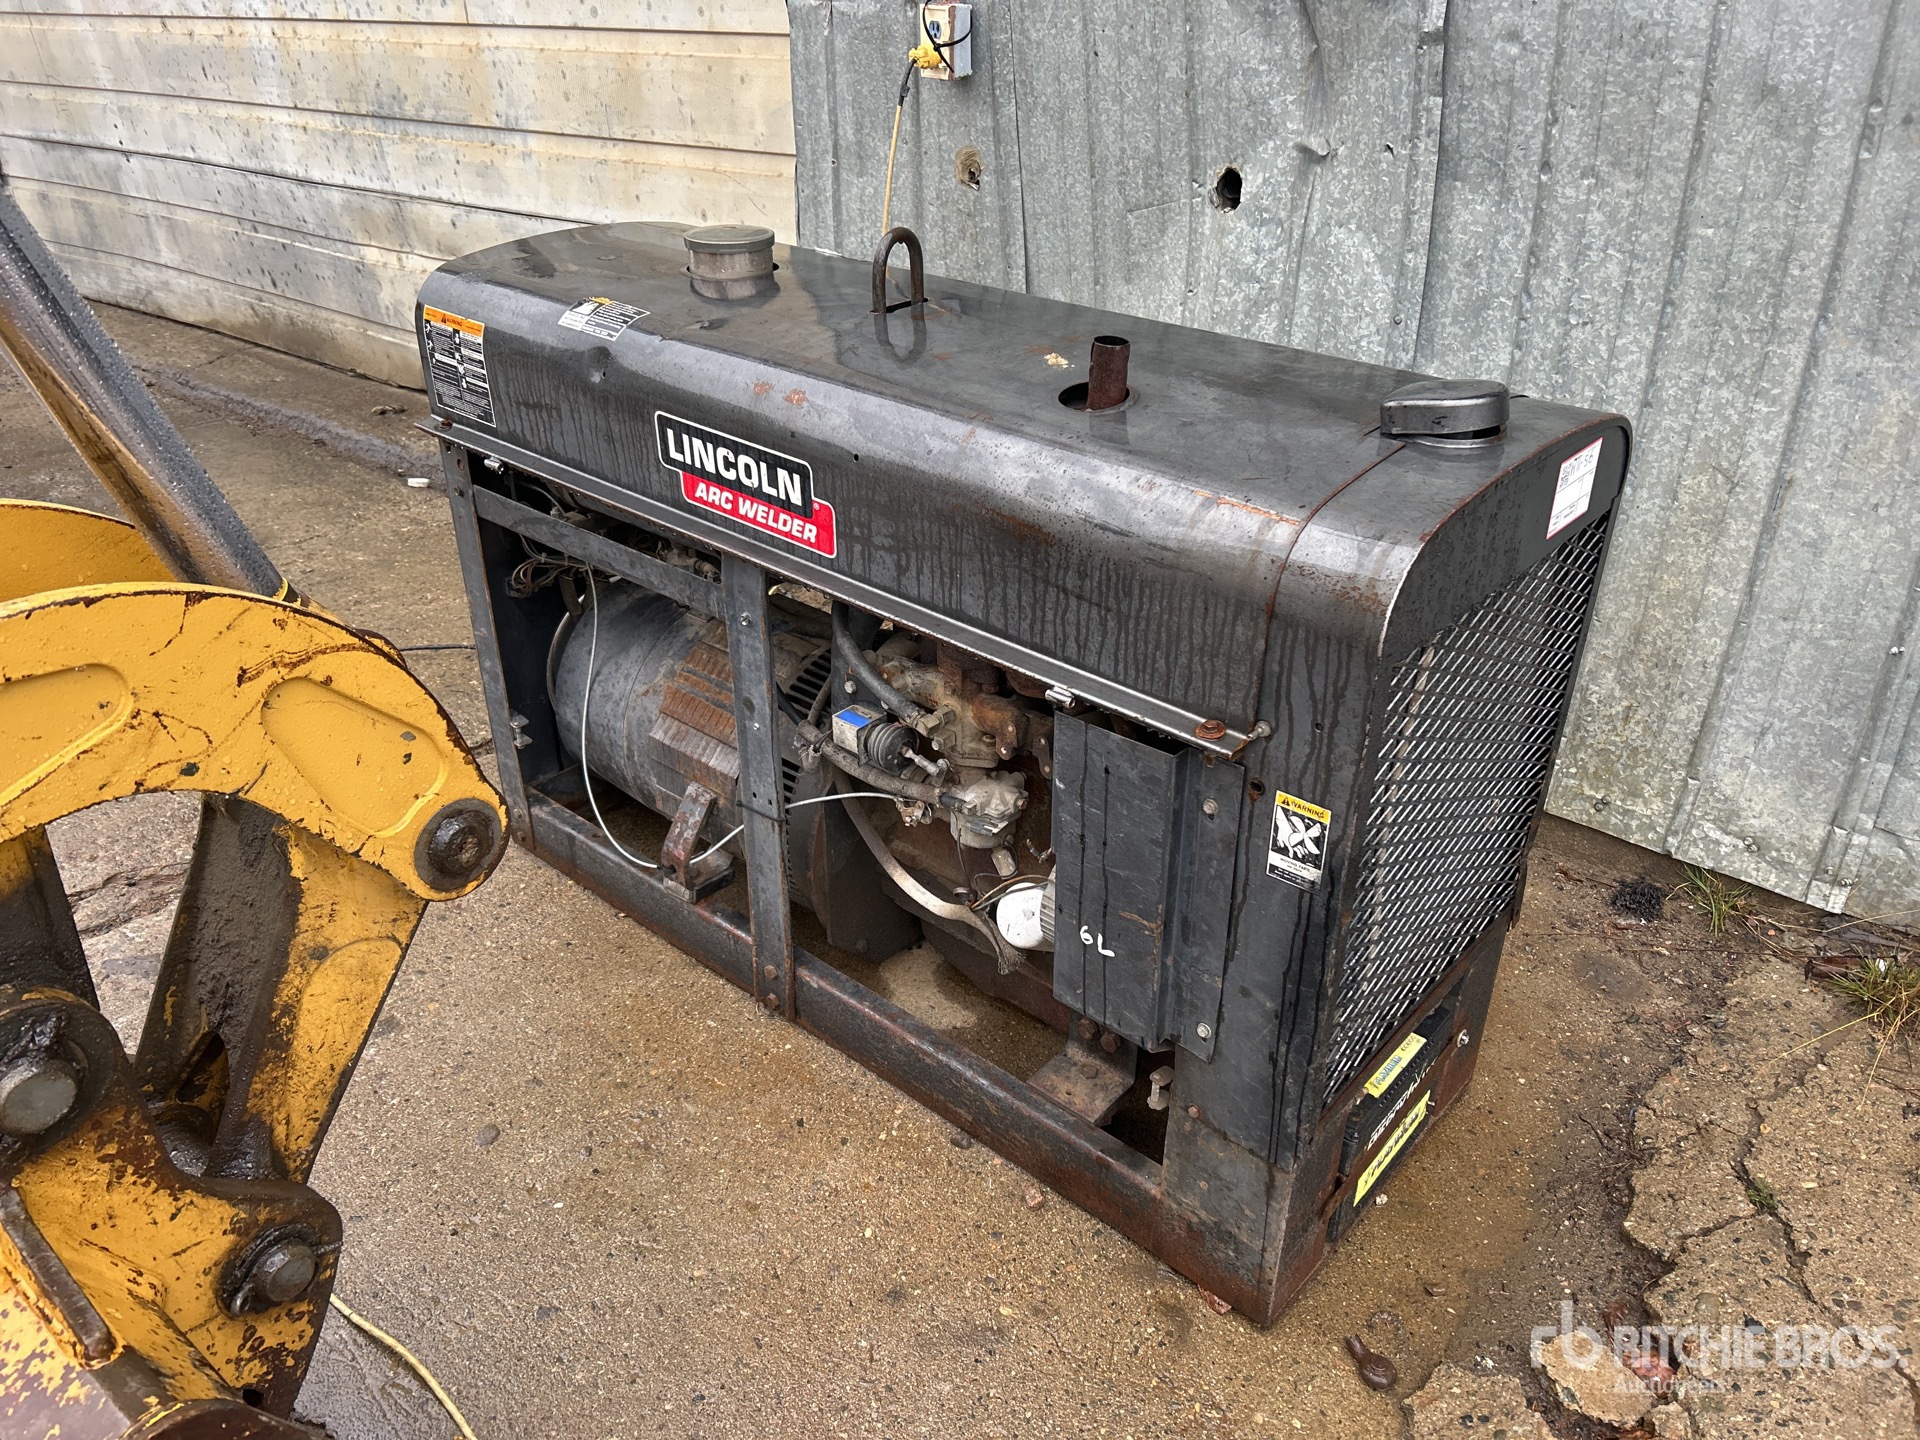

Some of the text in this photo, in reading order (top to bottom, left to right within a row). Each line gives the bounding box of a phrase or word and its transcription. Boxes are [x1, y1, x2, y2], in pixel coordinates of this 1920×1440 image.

[666, 428, 803, 507] LINCOLN
[695, 482, 818, 544] ARC WELDER
[1291, 799, 1325, 819] WARNING
